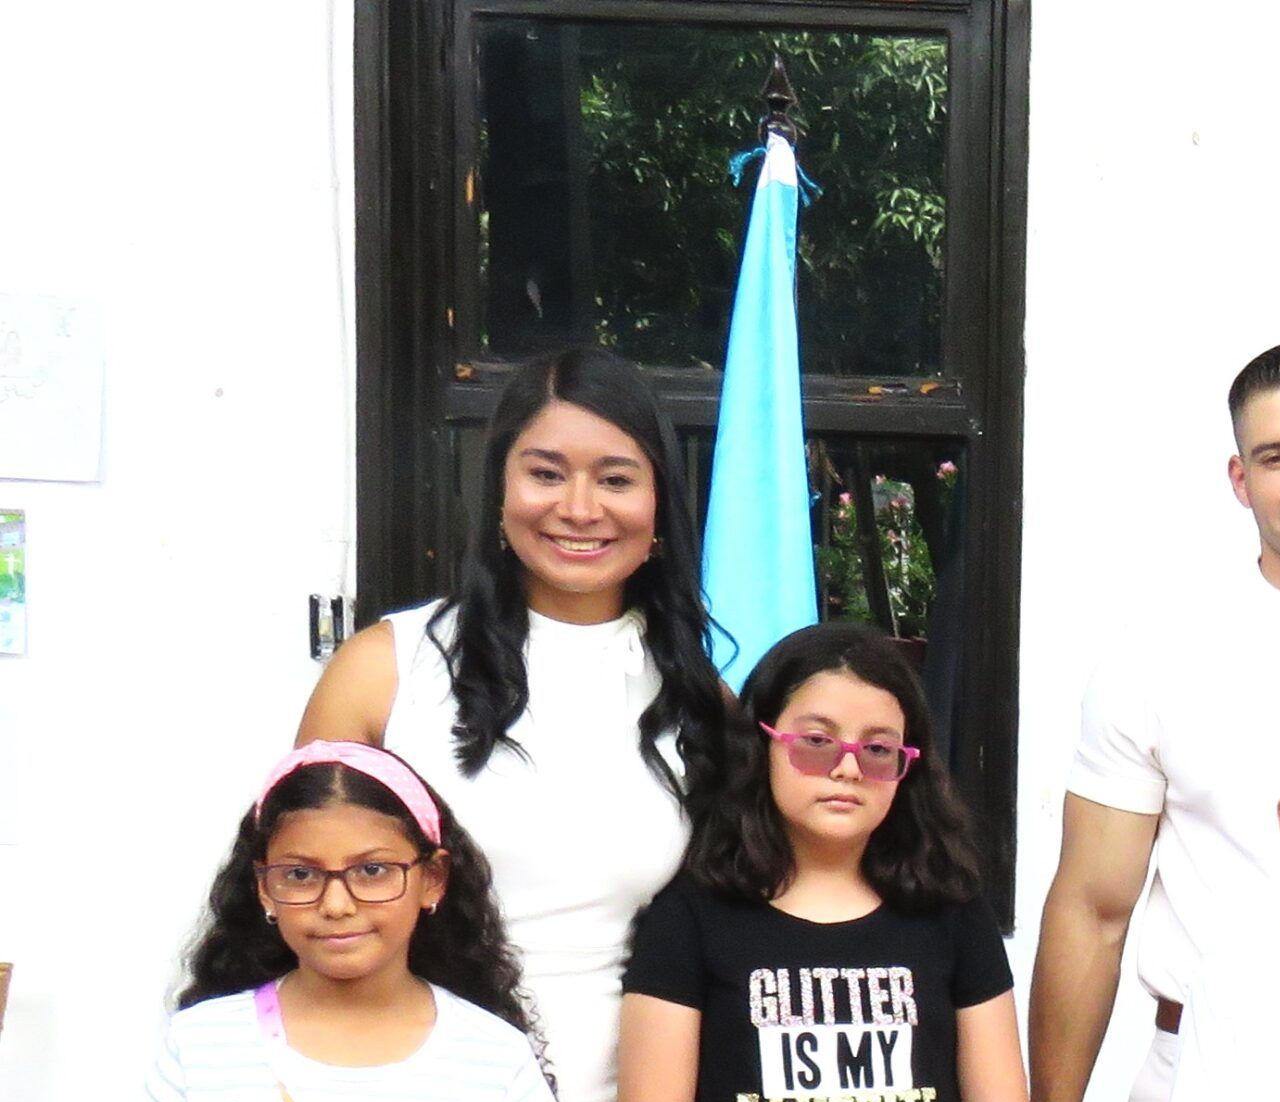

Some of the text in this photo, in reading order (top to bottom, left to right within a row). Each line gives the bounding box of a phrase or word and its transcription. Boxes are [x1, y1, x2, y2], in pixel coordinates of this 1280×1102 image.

[748, 966, 919, 1028] GLITTER
[781, 1029, 899, 1091] IS MY
